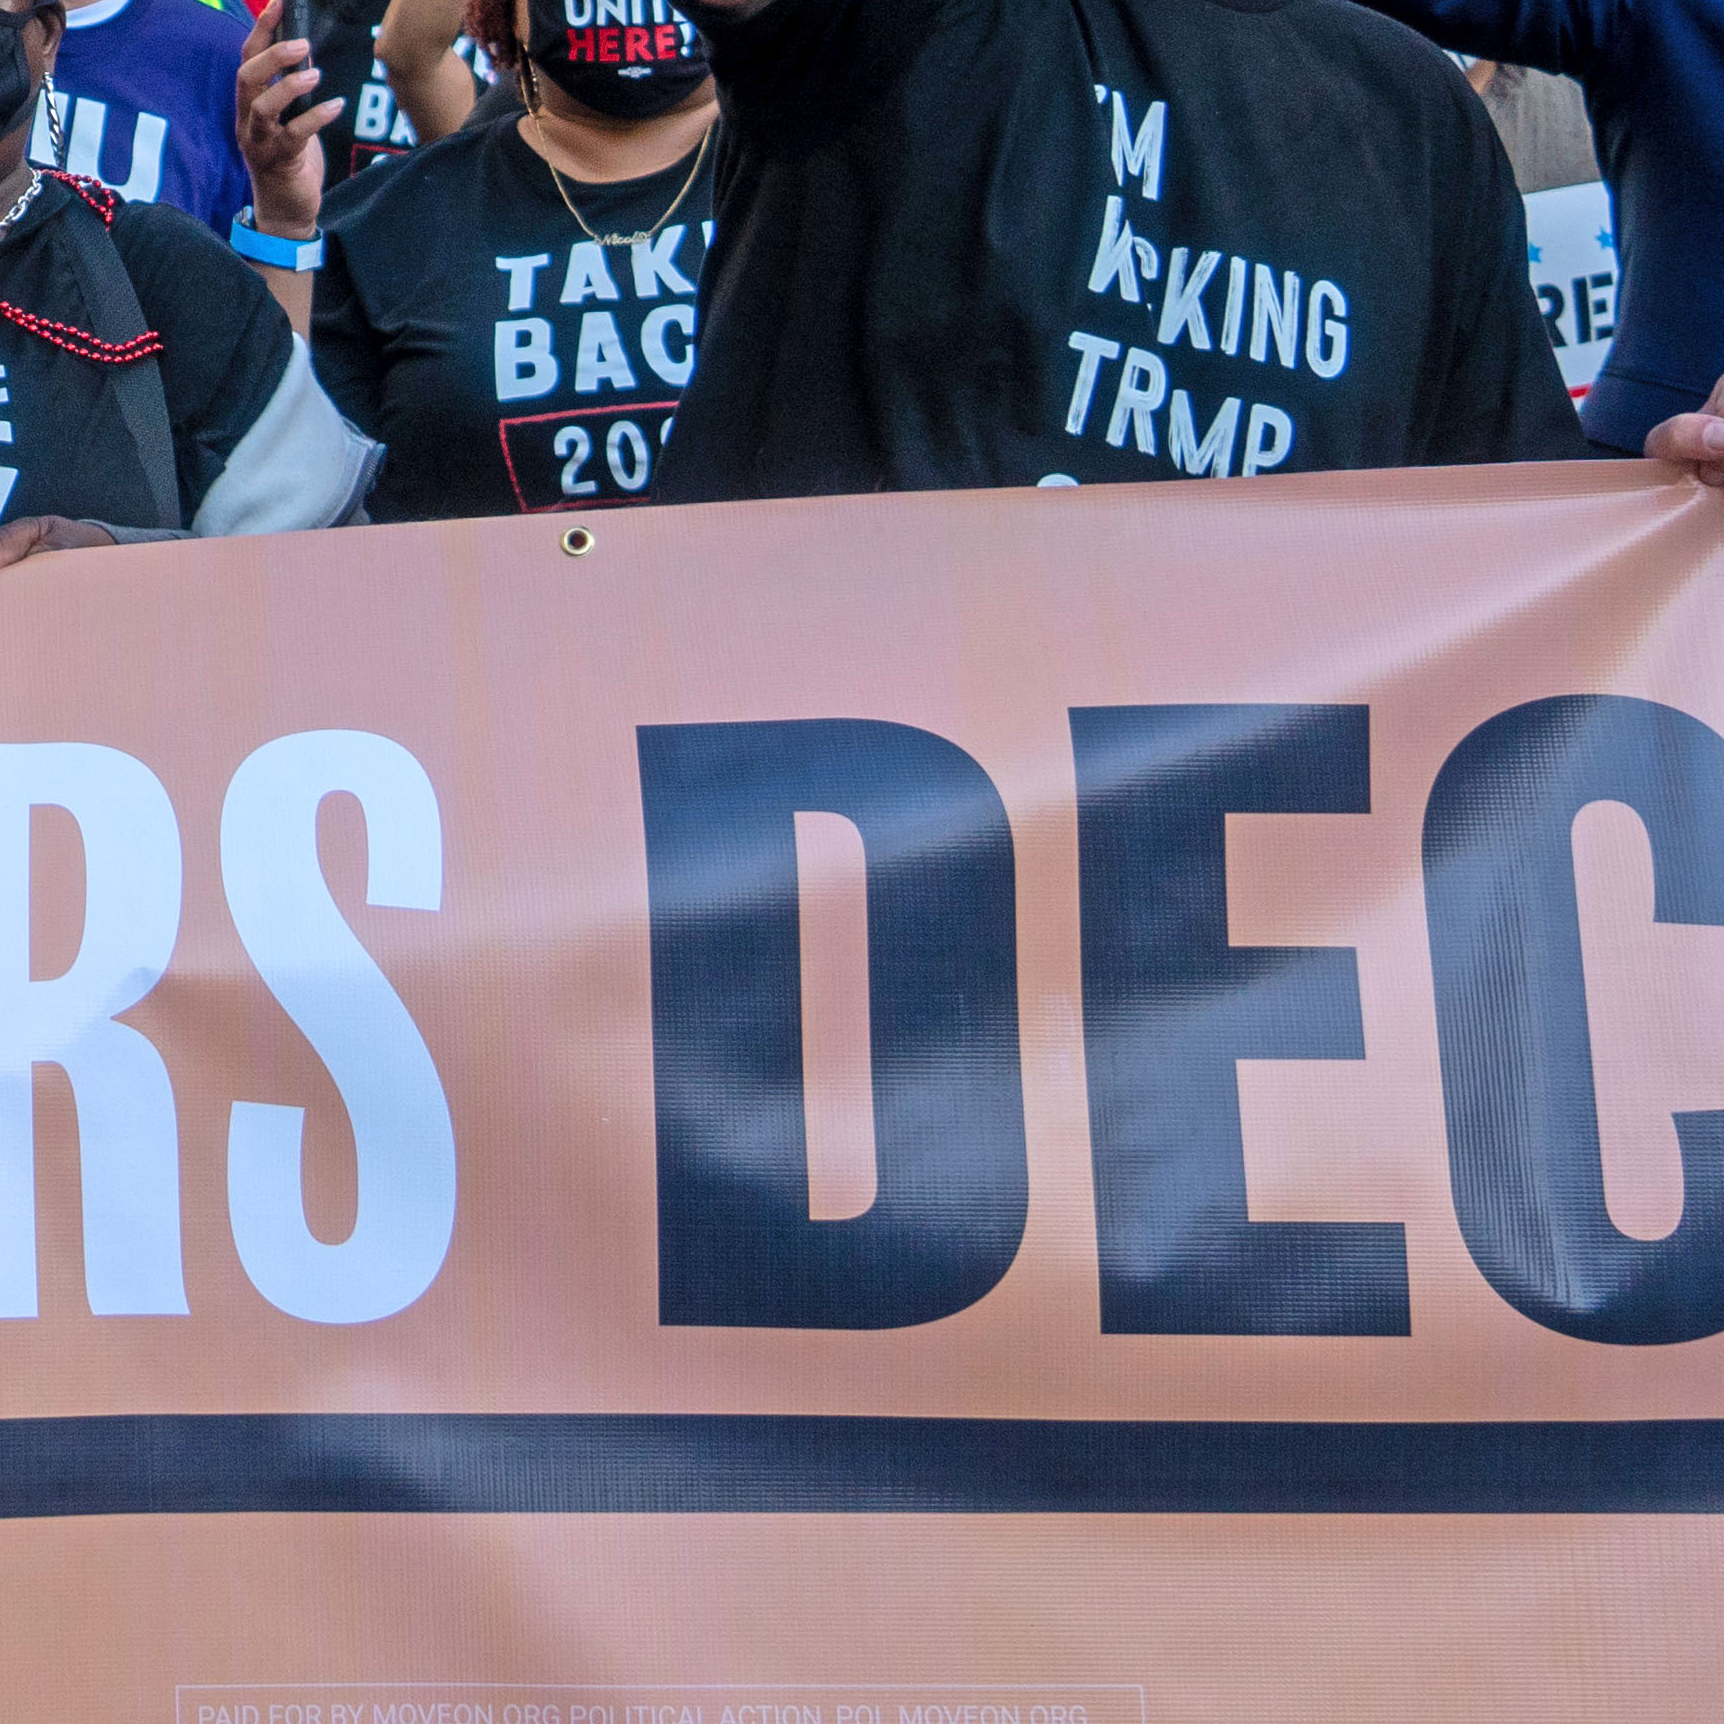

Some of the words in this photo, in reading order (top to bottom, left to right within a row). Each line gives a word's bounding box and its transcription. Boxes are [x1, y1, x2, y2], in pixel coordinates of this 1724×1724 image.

[566, 22, 695, 63] HERE!
[495, 220, 715, 311] TAK
[554, 417, 675, 496] 20
